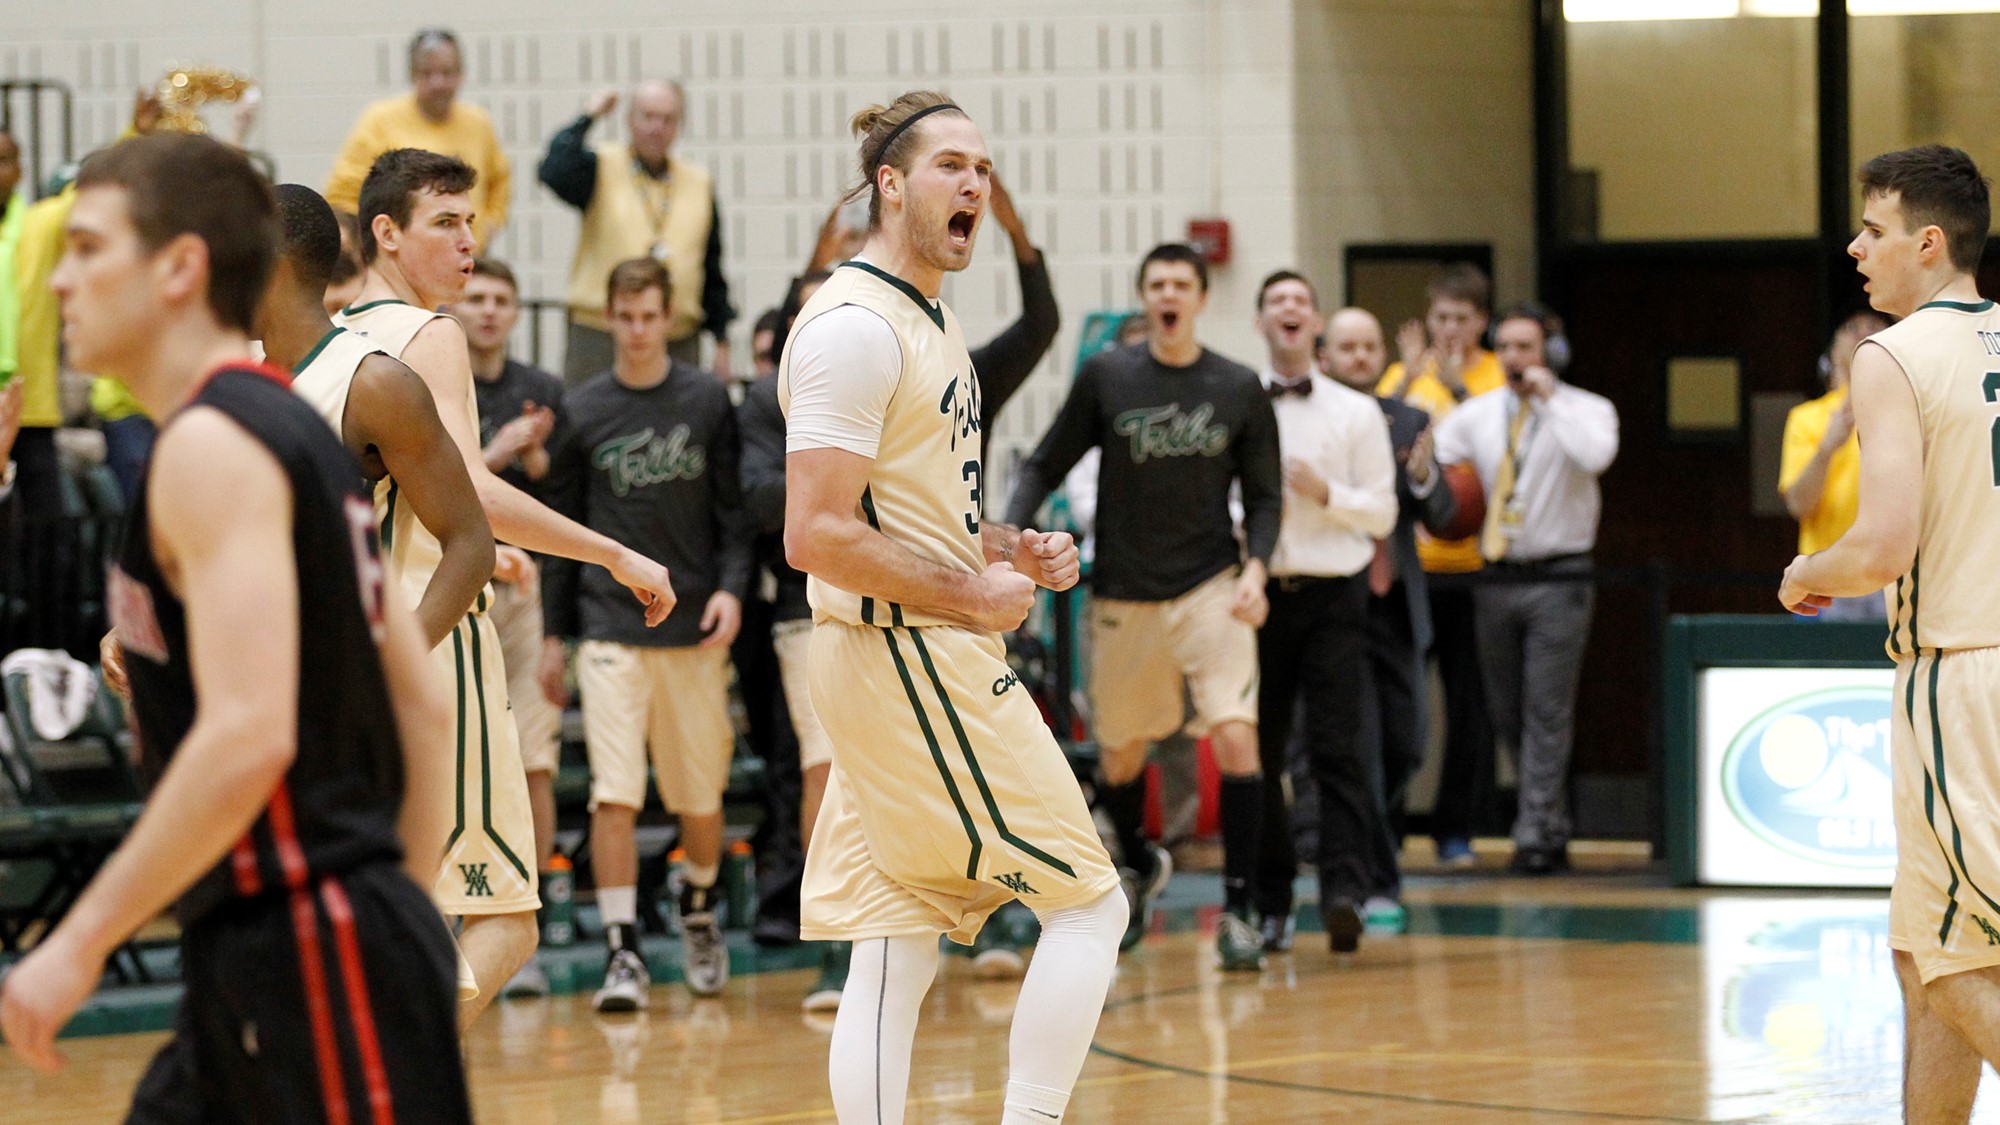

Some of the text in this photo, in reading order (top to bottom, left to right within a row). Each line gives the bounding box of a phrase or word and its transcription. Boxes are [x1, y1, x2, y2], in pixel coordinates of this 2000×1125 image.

[940, 363, 982, 452] Trib
[1114, 402, 1230, 464] Tribe
[592, 423, 706, 498] Tribe
